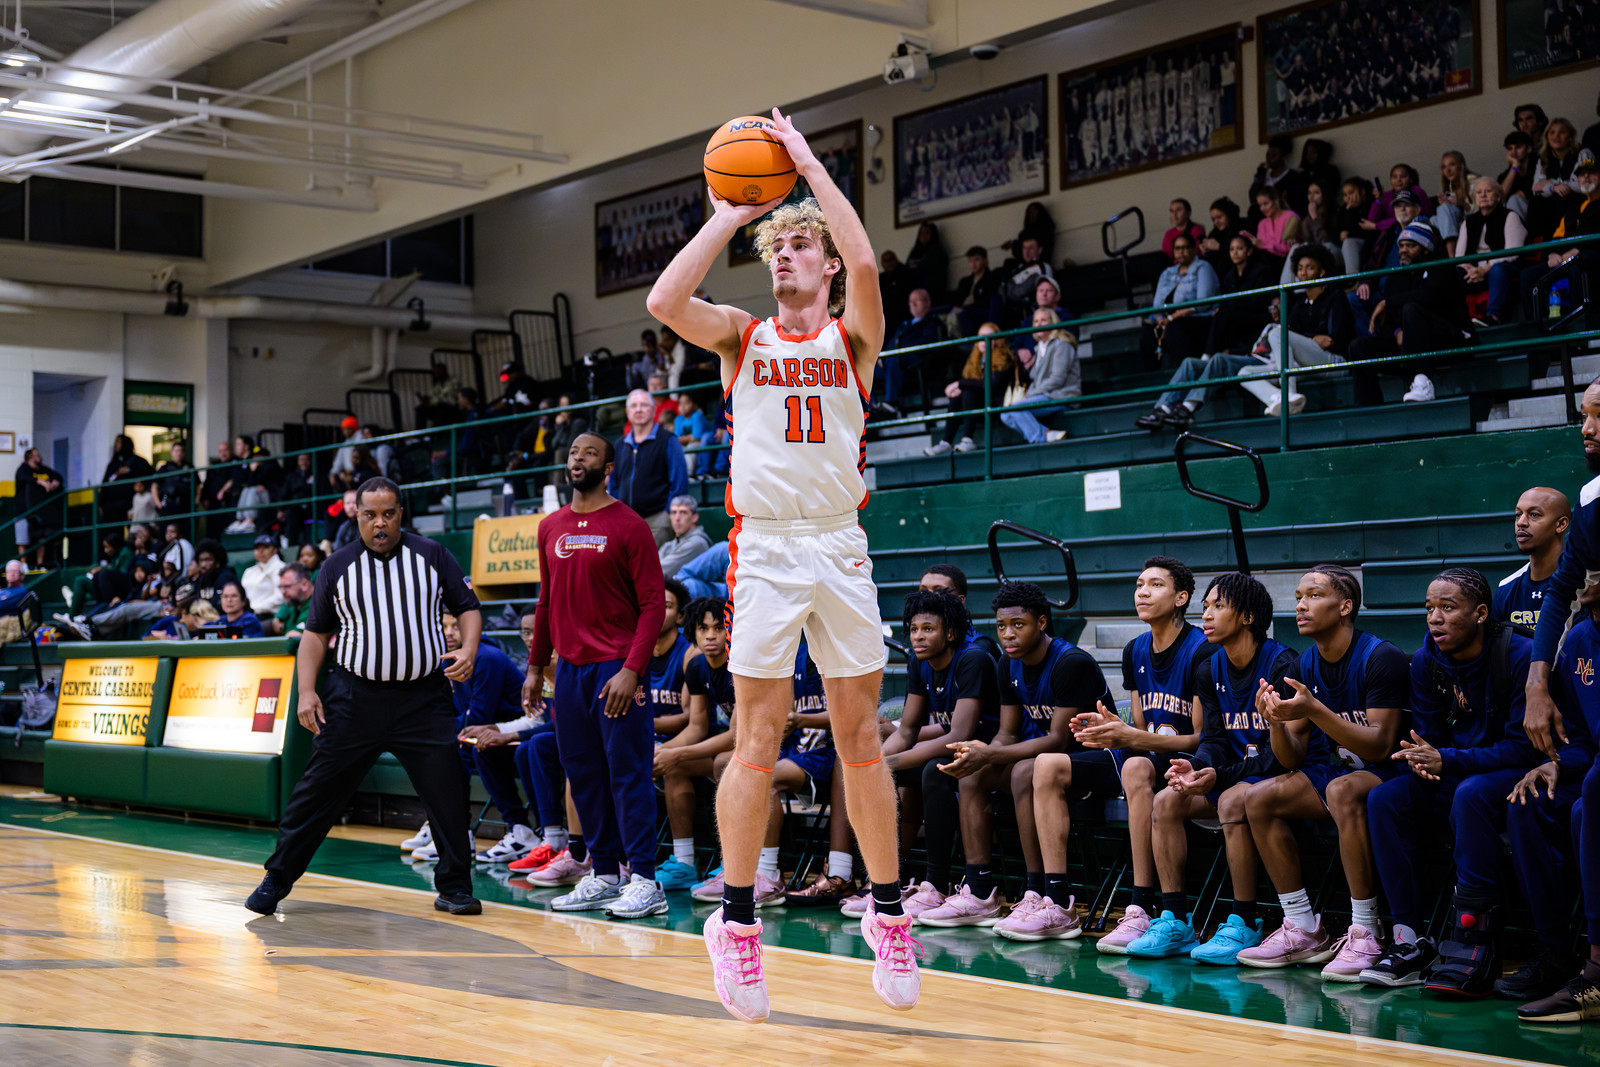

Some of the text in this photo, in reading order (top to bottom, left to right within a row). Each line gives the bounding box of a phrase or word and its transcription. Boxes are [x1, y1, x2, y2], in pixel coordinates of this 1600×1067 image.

[753, 358, 848, 389] CARSON
[785, 395, 826, 444] 11
[488, 529, 539, 554] Centra
[486, 559, 539, 573] BASK
[89, 665, 135, 677] WELCOME TO
[62, 681, 155, 698] CENTRAL CABARRUS
[178, 682, 200, 700] Good
[93, 713, 150, 736] VIKINGS
